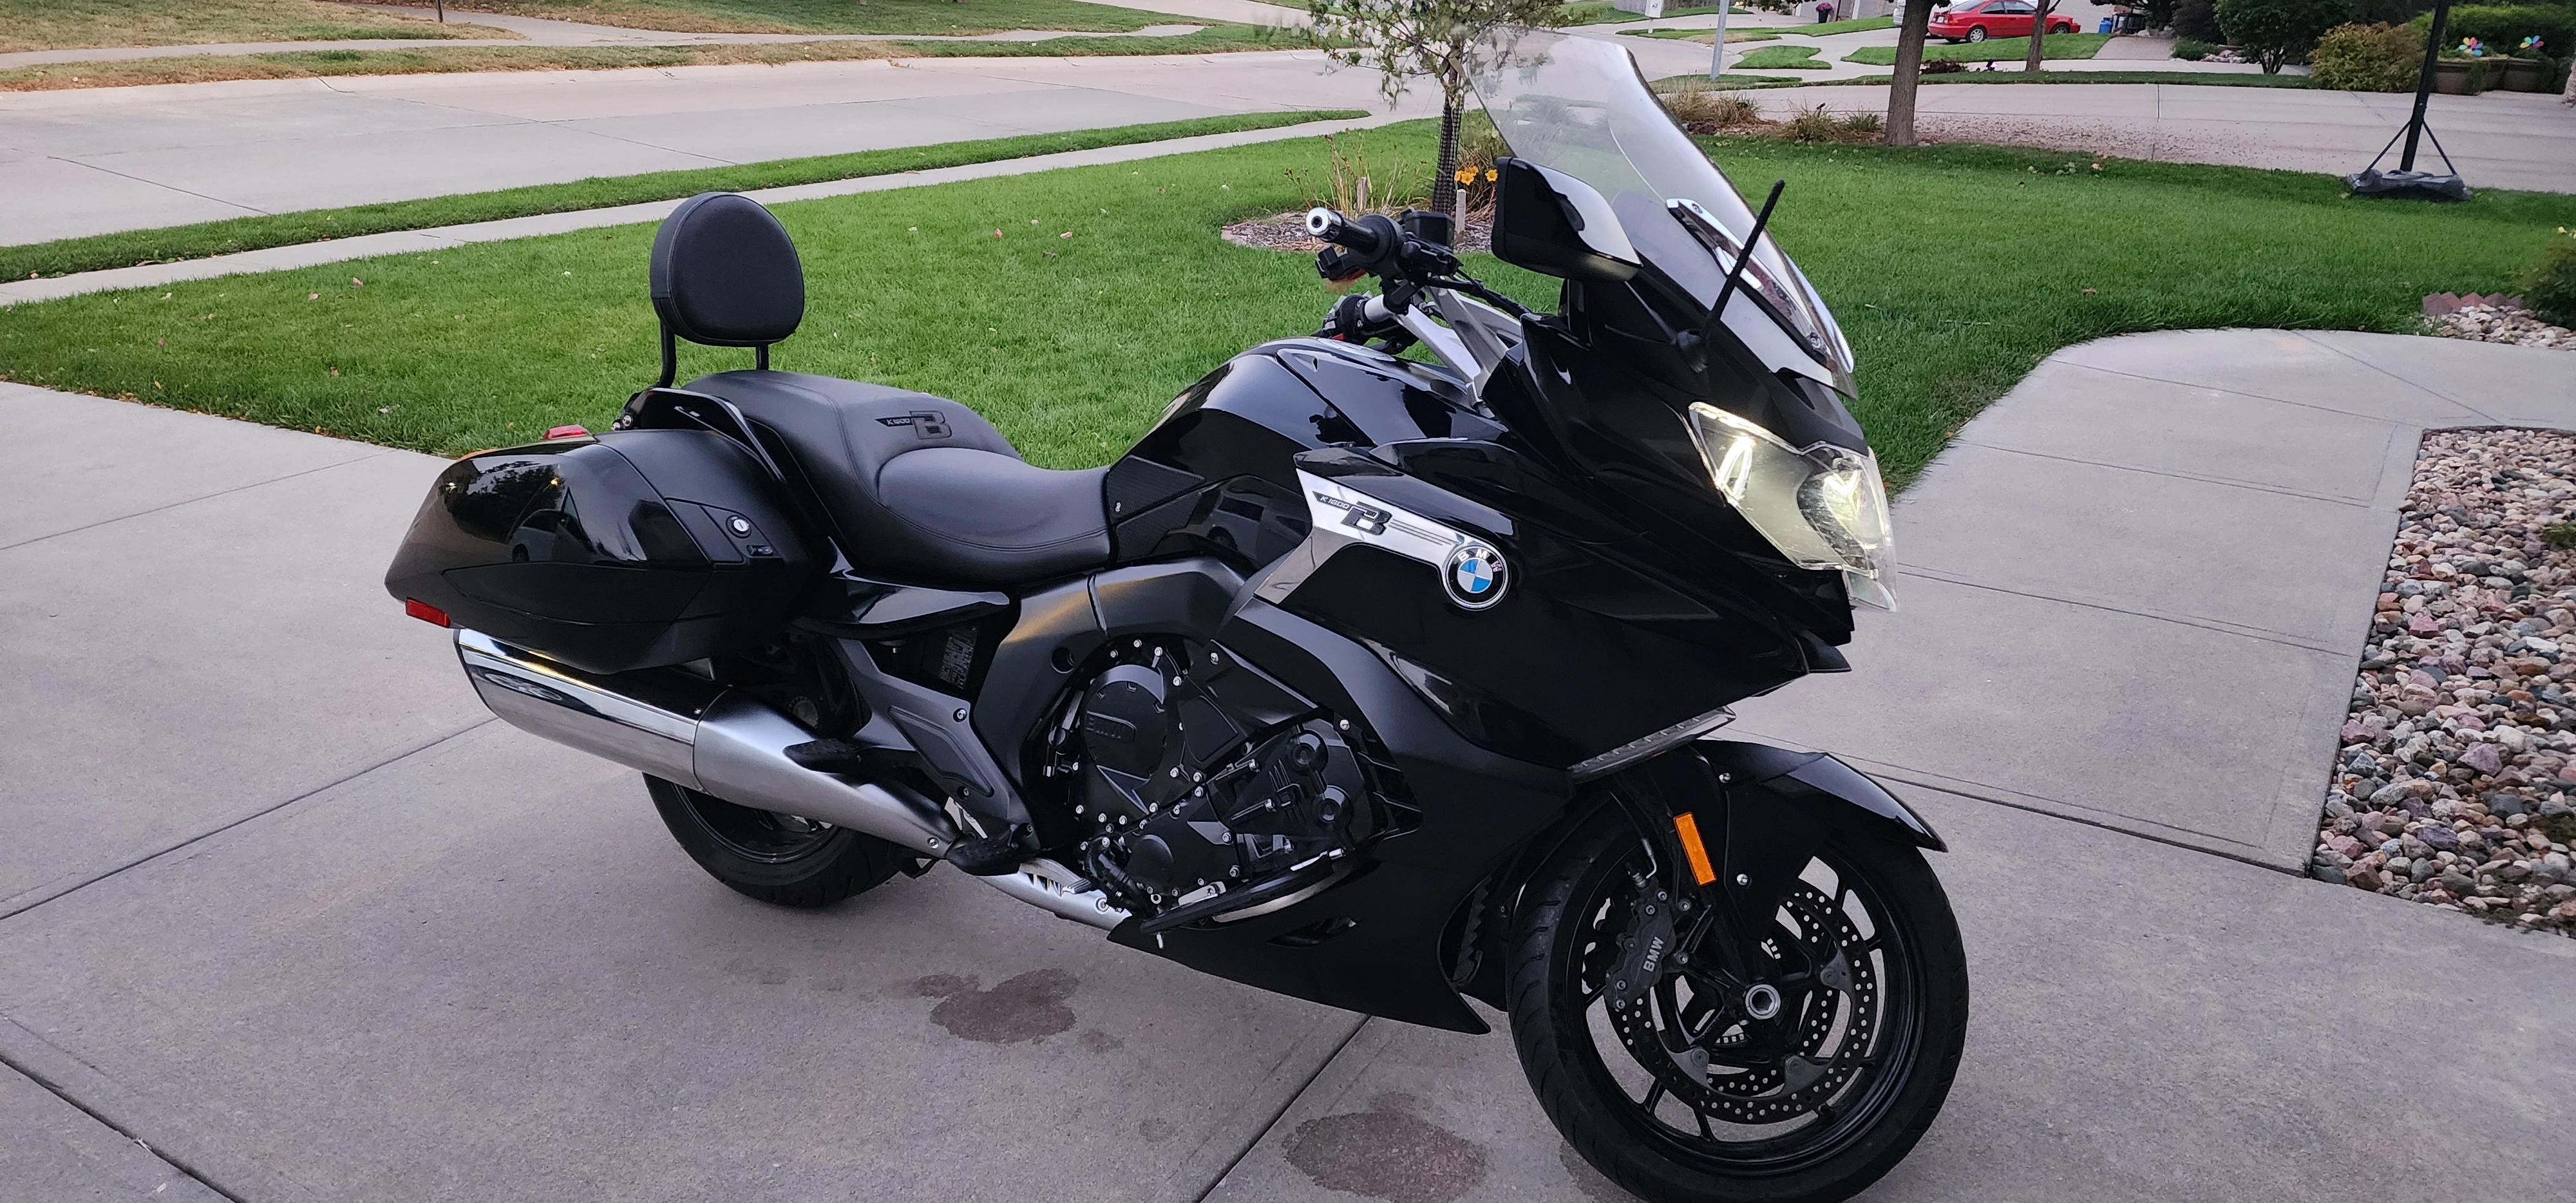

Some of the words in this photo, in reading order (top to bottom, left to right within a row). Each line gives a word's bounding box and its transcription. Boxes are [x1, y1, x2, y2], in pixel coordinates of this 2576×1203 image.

[909, 410, 952, 439] B
[1340, 500, 1393, 536] B
[1457, 548, 1502, 573] BMW
[1643, 936, 1664, 972] BMW
